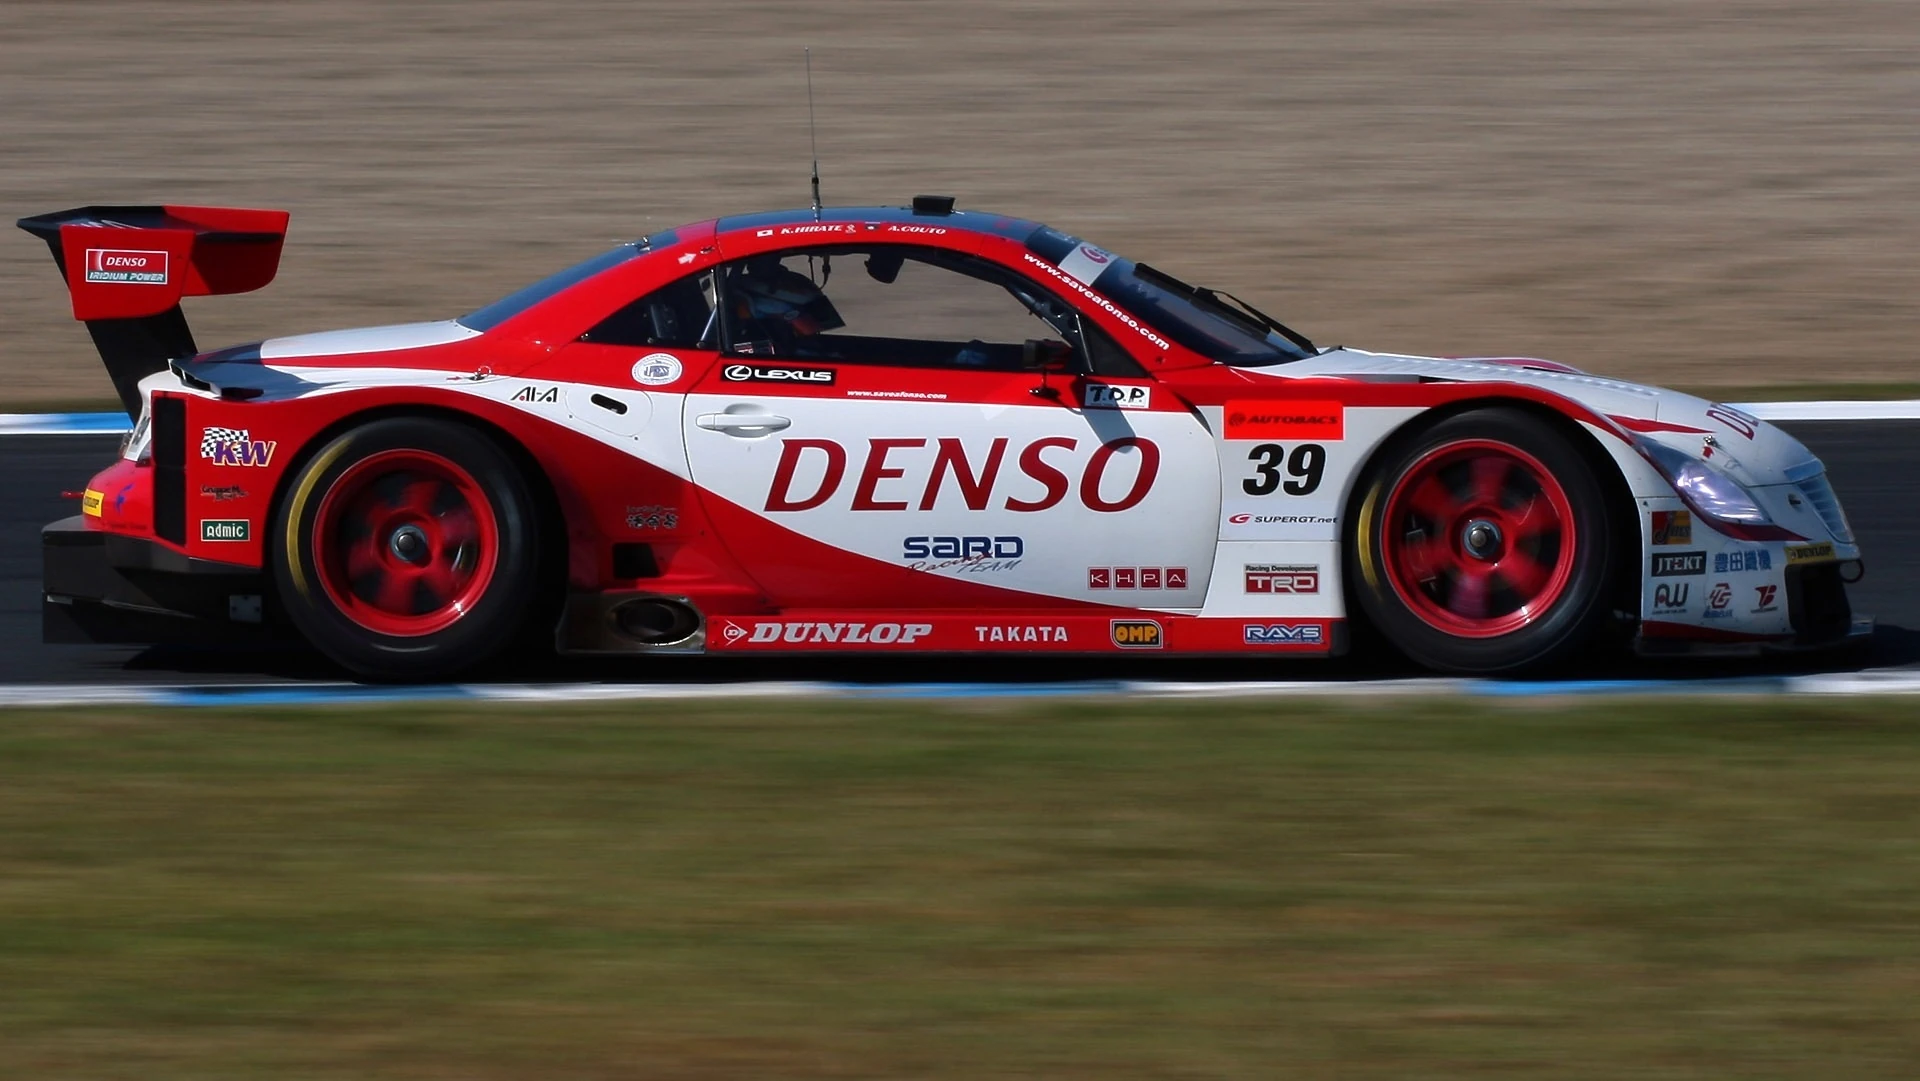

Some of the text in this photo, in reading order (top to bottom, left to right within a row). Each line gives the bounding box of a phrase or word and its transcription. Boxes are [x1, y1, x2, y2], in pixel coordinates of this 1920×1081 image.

[780, 224, 843, 235] K.HIRATE
[888, 225, 946, 235] A.COUTO
[106, 256, 147, 267] DENSO
[89, 271, 164, 282] IRIDIUM POWER
[1023, 252, 1170, 351] www.saveafonso.com
[754, 368, 832, 382] LEXUS
[1247, 415, 1338, 425] AUTOBACS
[213, 441, 277, 467] KW
[763, 436, 1161, 513] DENSO
[1242, 443, 1327, 496] 39
[1254, 516, 1338, 524] SUPERGT.net
[1271, 565, 1318, 573] Development
[1657, 556, 1703, 574] JTEKT
[1248, 576, 1315, 593] TRD
[747, 622, 933, 644] DUNLOP
[975, 626, 1068, 642] TAKATA
[1115, 626, 1157, 642] OMP
[1246, 627, 1319, 638] RAYS
